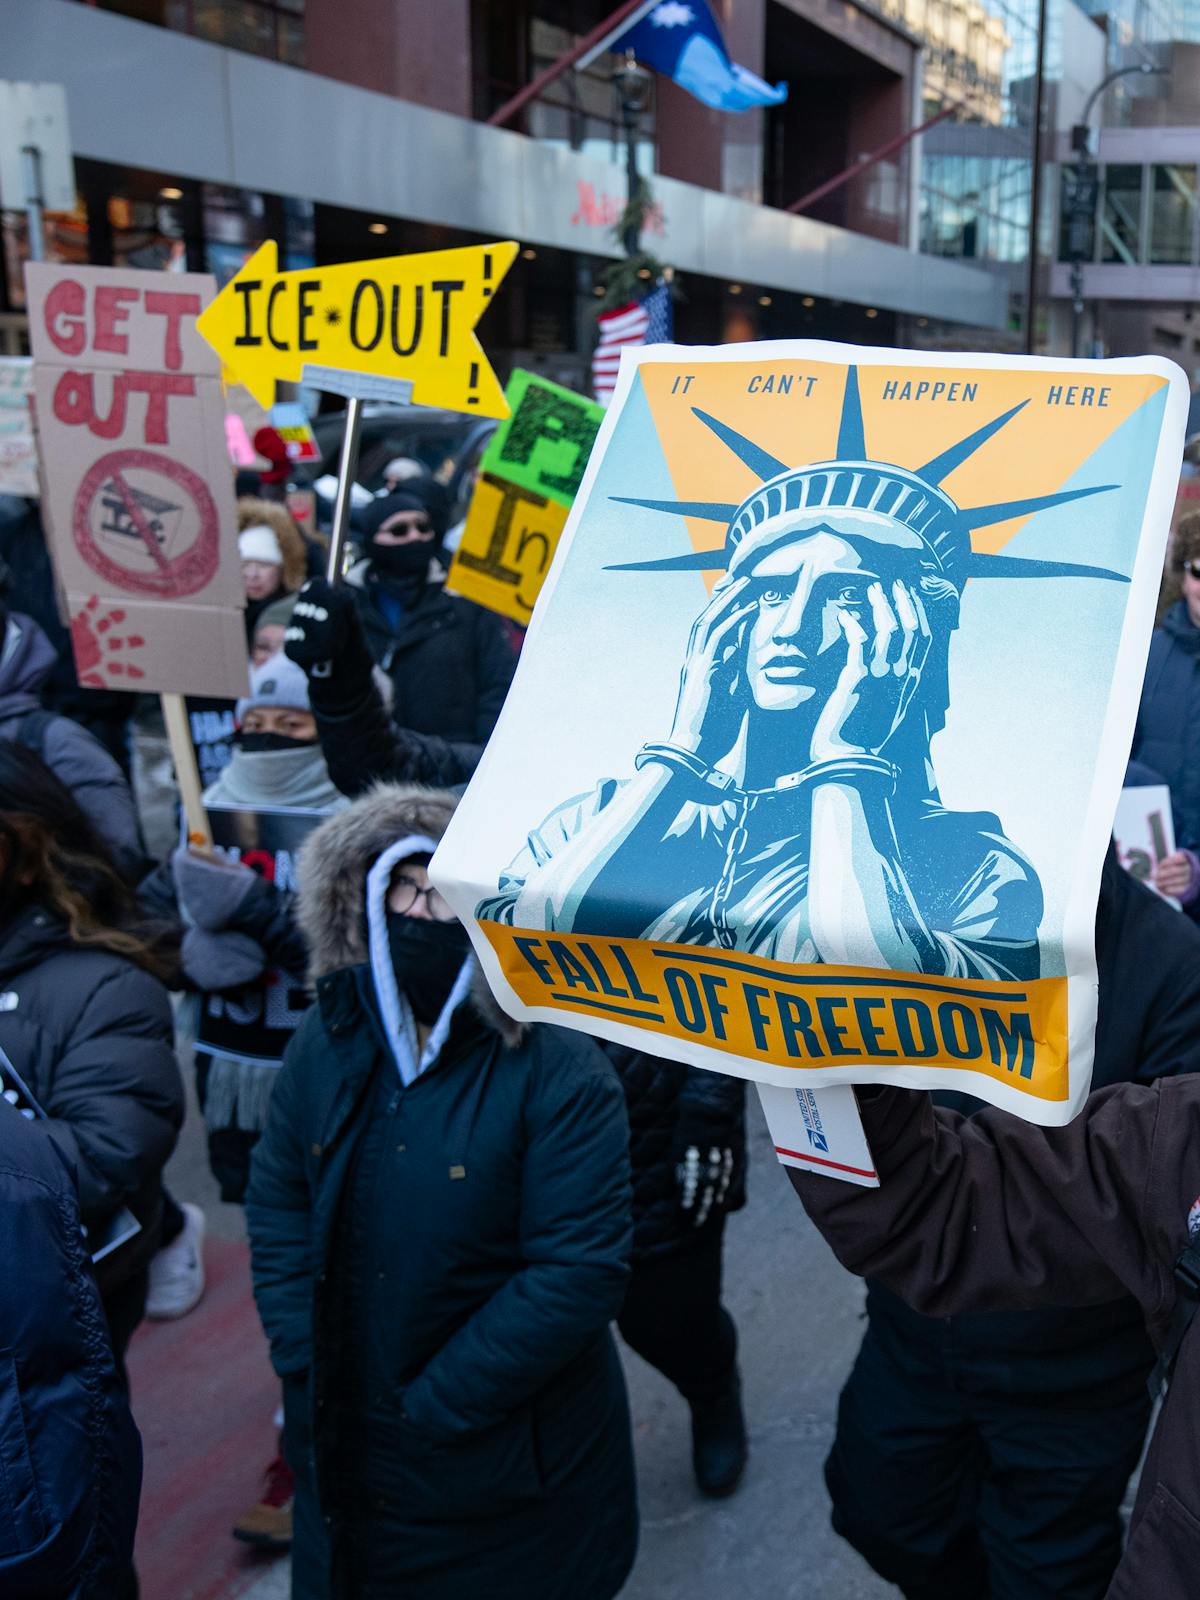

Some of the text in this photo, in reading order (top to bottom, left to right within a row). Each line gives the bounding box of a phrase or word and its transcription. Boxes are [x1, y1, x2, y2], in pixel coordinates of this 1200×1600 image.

[44, 279, 200, 371] GET
[671, 374, 1112, 407] IT CAN'T HAPPEN HERE
[513, 936, 1034, 1080] FALL OF FREEDOM
[799, 1102, 811, 1128] UNITED
[812, 1108, 824, 1133] POSTAL
